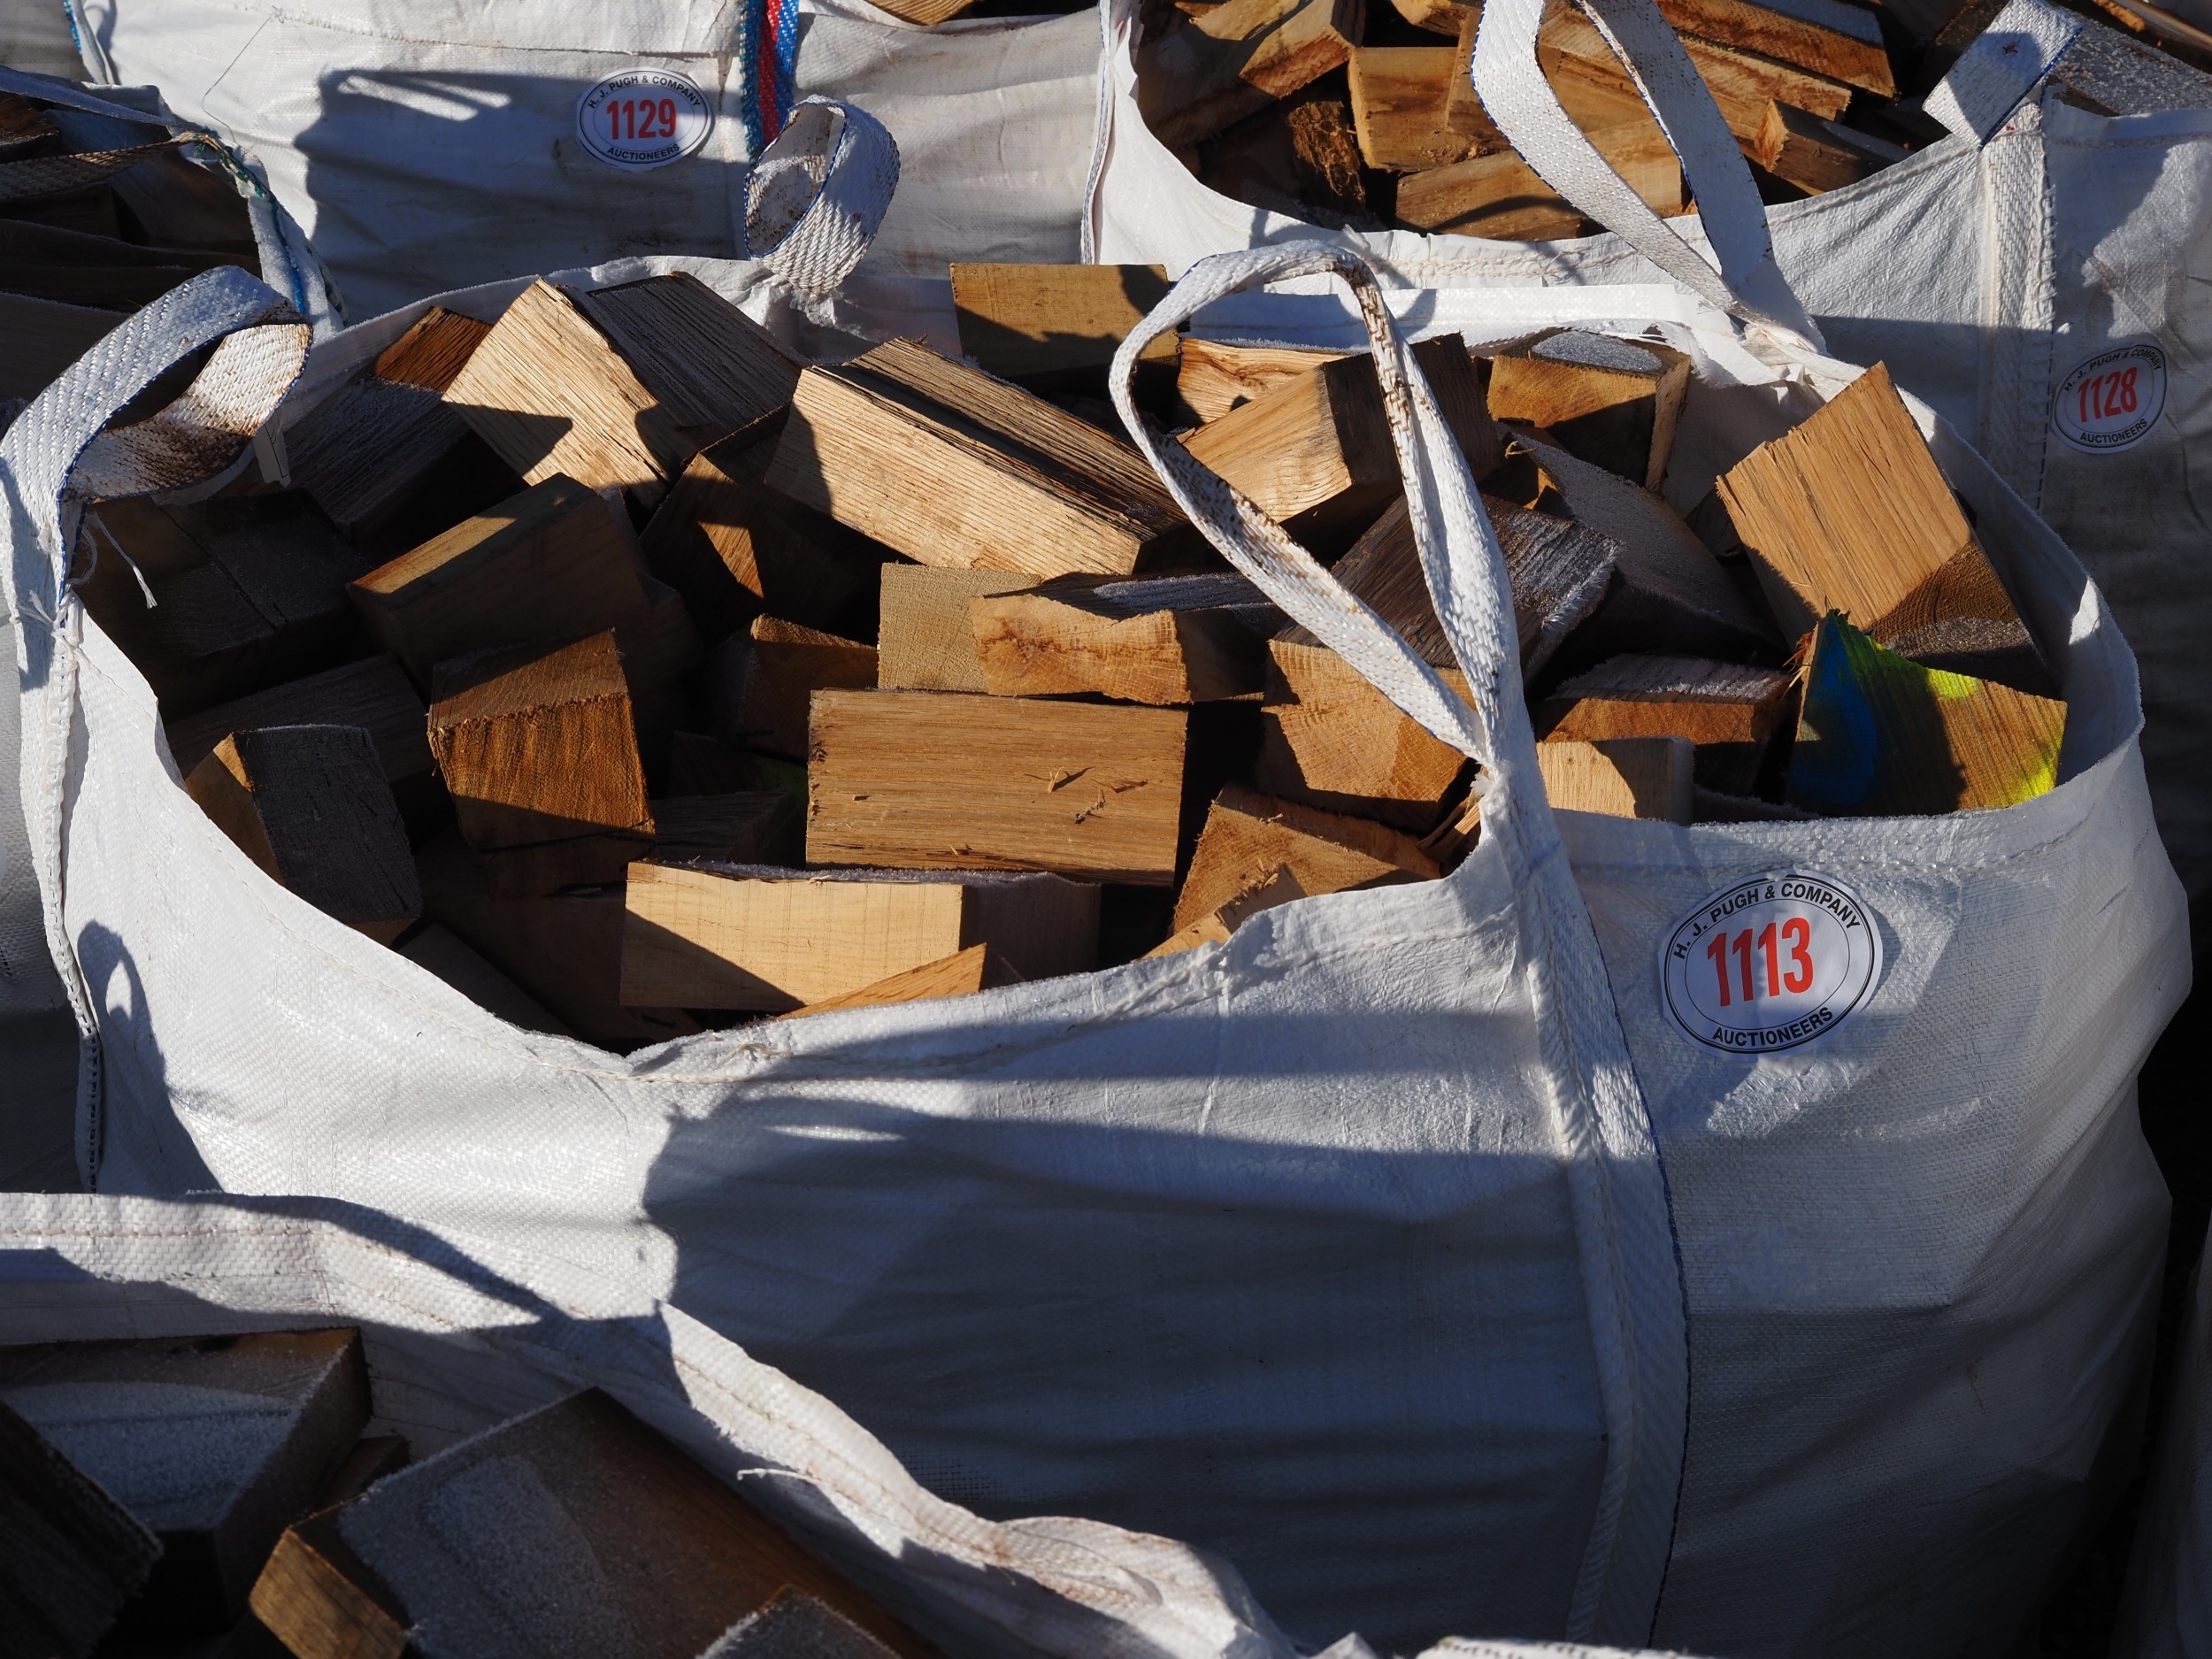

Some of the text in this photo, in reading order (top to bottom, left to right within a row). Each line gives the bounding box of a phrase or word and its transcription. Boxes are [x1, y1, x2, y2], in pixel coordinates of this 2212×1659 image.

[588, 99, 599, 109] H.
[600, 89, 608, 98] J.
[609, 76, 638, 91] PUGH
[652, 76, 701, 106] COMPANY
[607, 98, 677, 140] 1129
[607, 143, 680, 160] AUCTIONEERS
[2064, 381, 2076, 392] H.
[2089, 353, 2121, 370] PUGH
[2131, 349, 2162, 370] COMPANY
[2078, 366, 2138, 423] 1128
[2080, 419, 2147, 443] AUCTIONEERS
[1673, 883, 1861, 959] H. J. PUGH & COMPANY
[1707, 917, 1814, 1007] 1113
[1713, 1007, 1833, 1046] AUCTIONEERS
